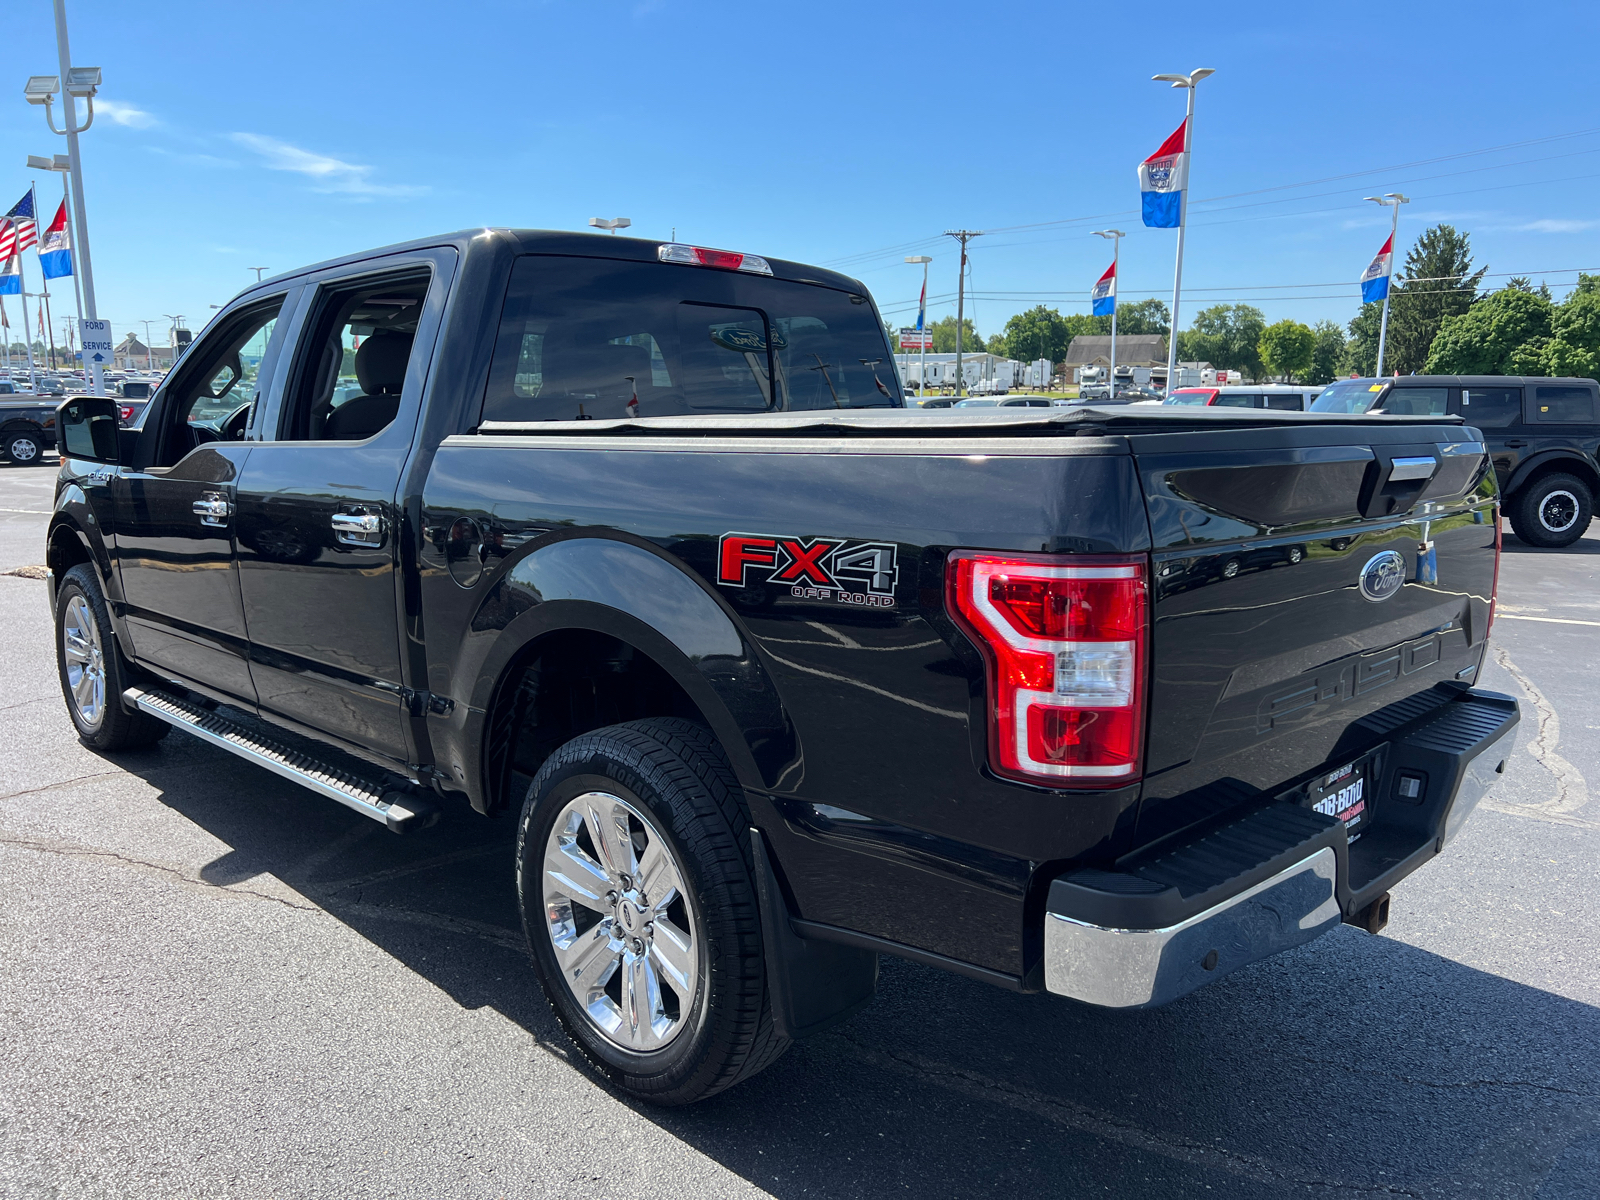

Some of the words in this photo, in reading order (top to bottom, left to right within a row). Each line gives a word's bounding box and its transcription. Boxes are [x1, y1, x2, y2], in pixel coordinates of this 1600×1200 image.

[85, 321, 104, 330] FORD
[82, 341, 112, 350] SERVICE
[717, 530, 898, 597] FX4
[791, 585, 831, 600] OFF
[837, 590, 895, 608] ROAD
[1256, 635, 1442, 735] F-150
[606, 762, 659, 809] MOHAVE
